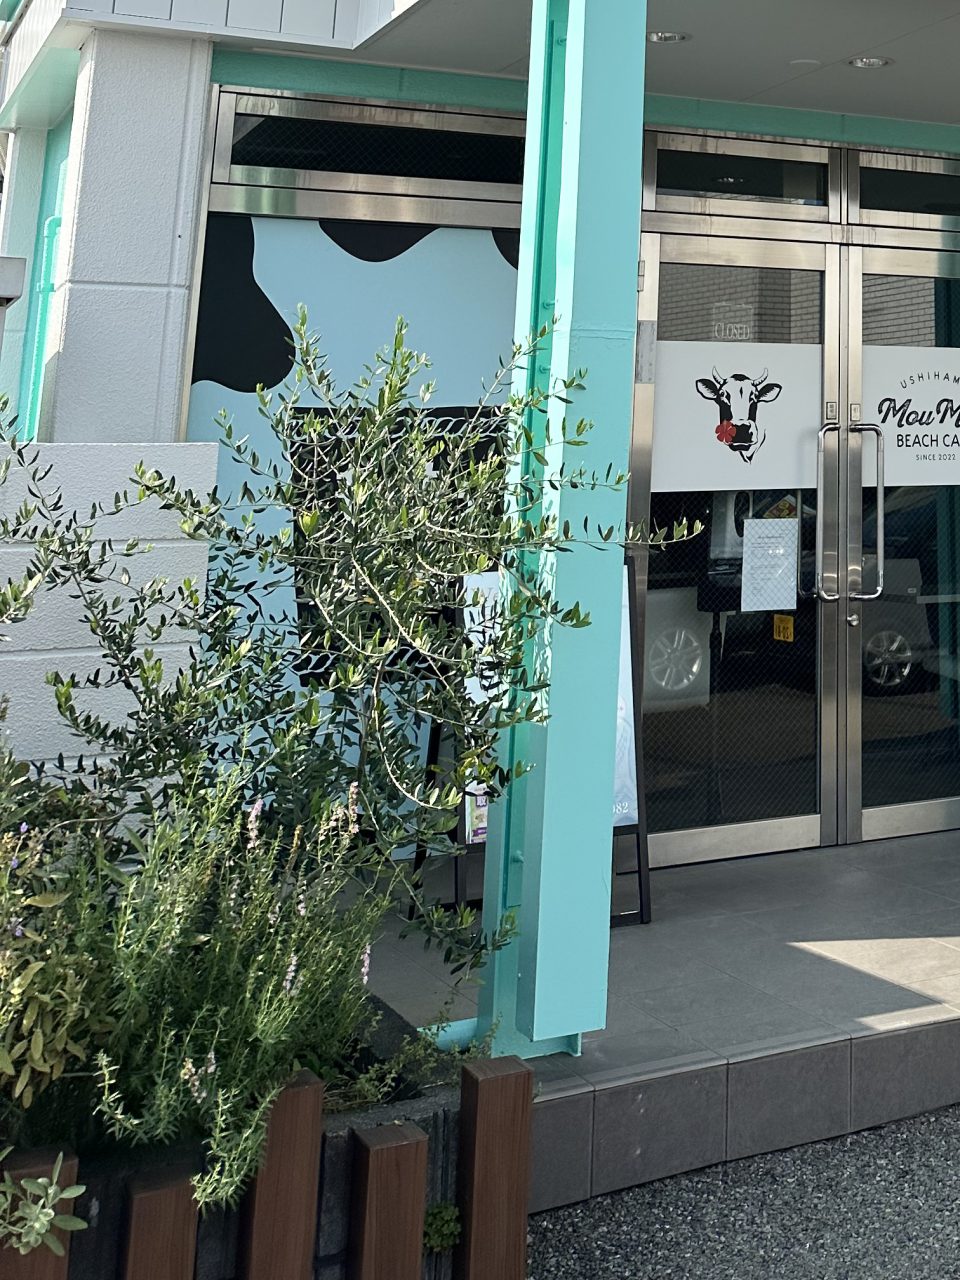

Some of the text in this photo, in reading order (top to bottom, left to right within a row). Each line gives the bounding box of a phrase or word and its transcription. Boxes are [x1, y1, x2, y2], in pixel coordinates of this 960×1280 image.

[714, 322, 750, 340] CLOSED
[896, 434, 939, 448] BEACH
[916, 453, 956, 461] SINCE 2022
